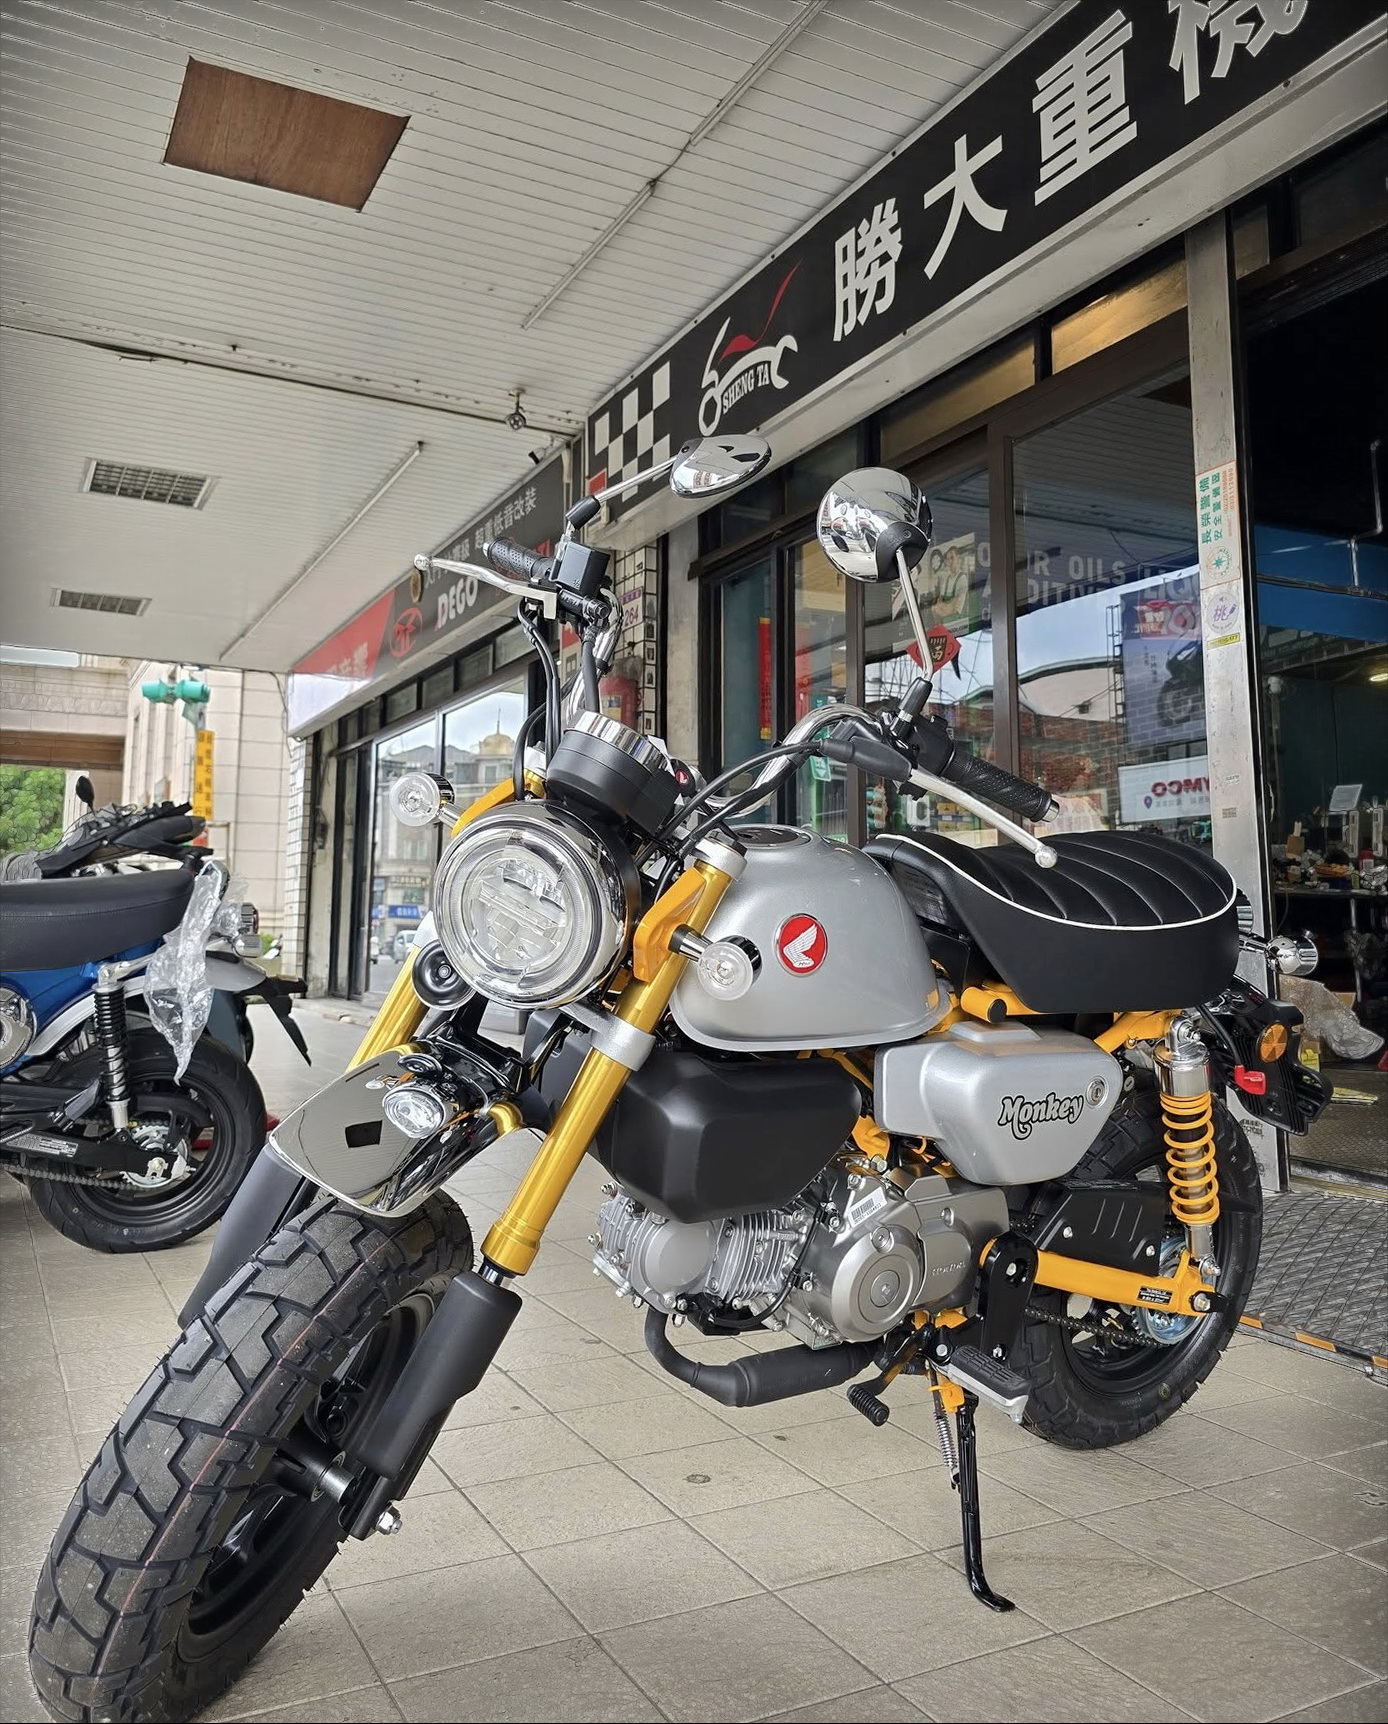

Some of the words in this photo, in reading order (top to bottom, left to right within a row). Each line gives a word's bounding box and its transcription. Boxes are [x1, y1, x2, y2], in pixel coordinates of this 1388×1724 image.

[722, 368, 755, 415] SHENG
[756, 363, 770, 388] TA
[1069, 555, 1126, 585] OILS
[437, 577, 478, 627] DEGO
[997, 1091, 1084, 1140] Monkey
